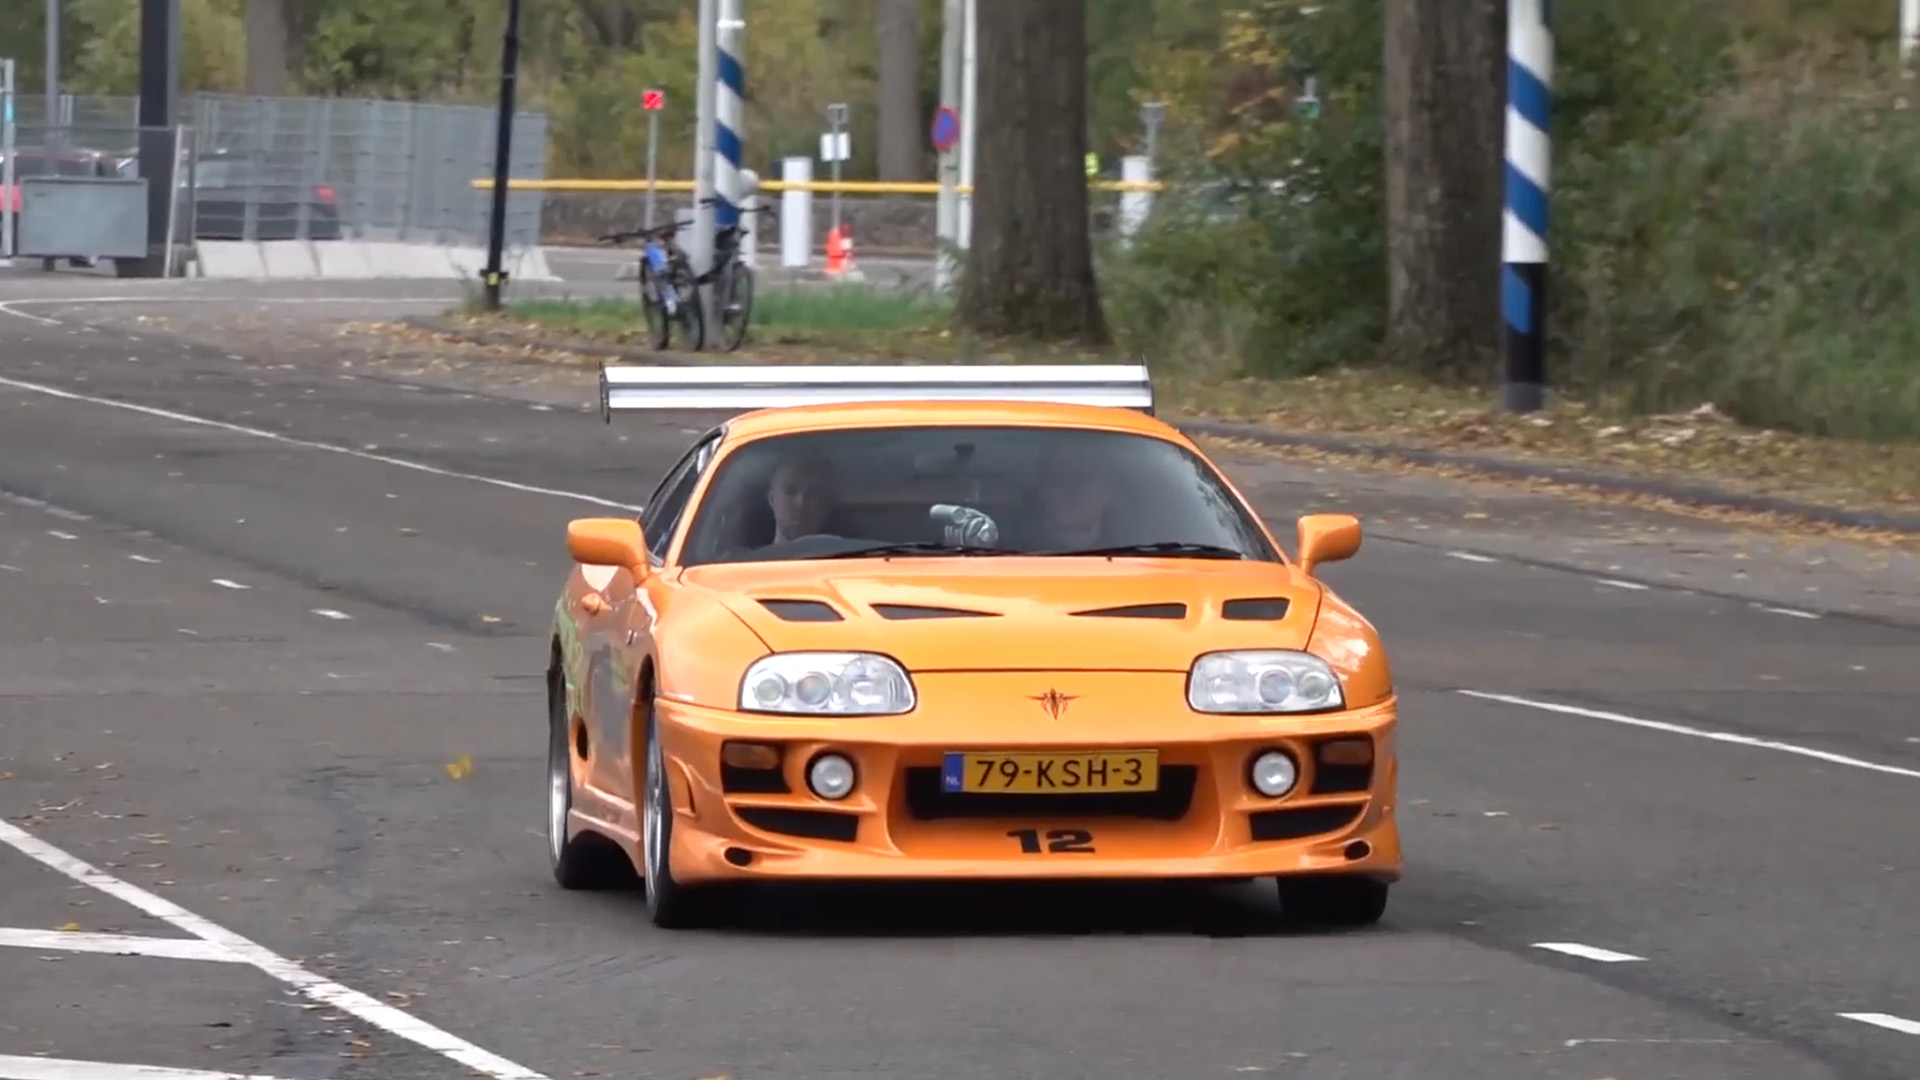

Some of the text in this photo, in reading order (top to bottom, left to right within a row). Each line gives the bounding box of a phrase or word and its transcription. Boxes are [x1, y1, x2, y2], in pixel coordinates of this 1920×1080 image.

[945, 776, 960, 786] NL
[976, 758, 1142, 788] 79-KSH-3
[1006, 829, 1096, 854] 12
